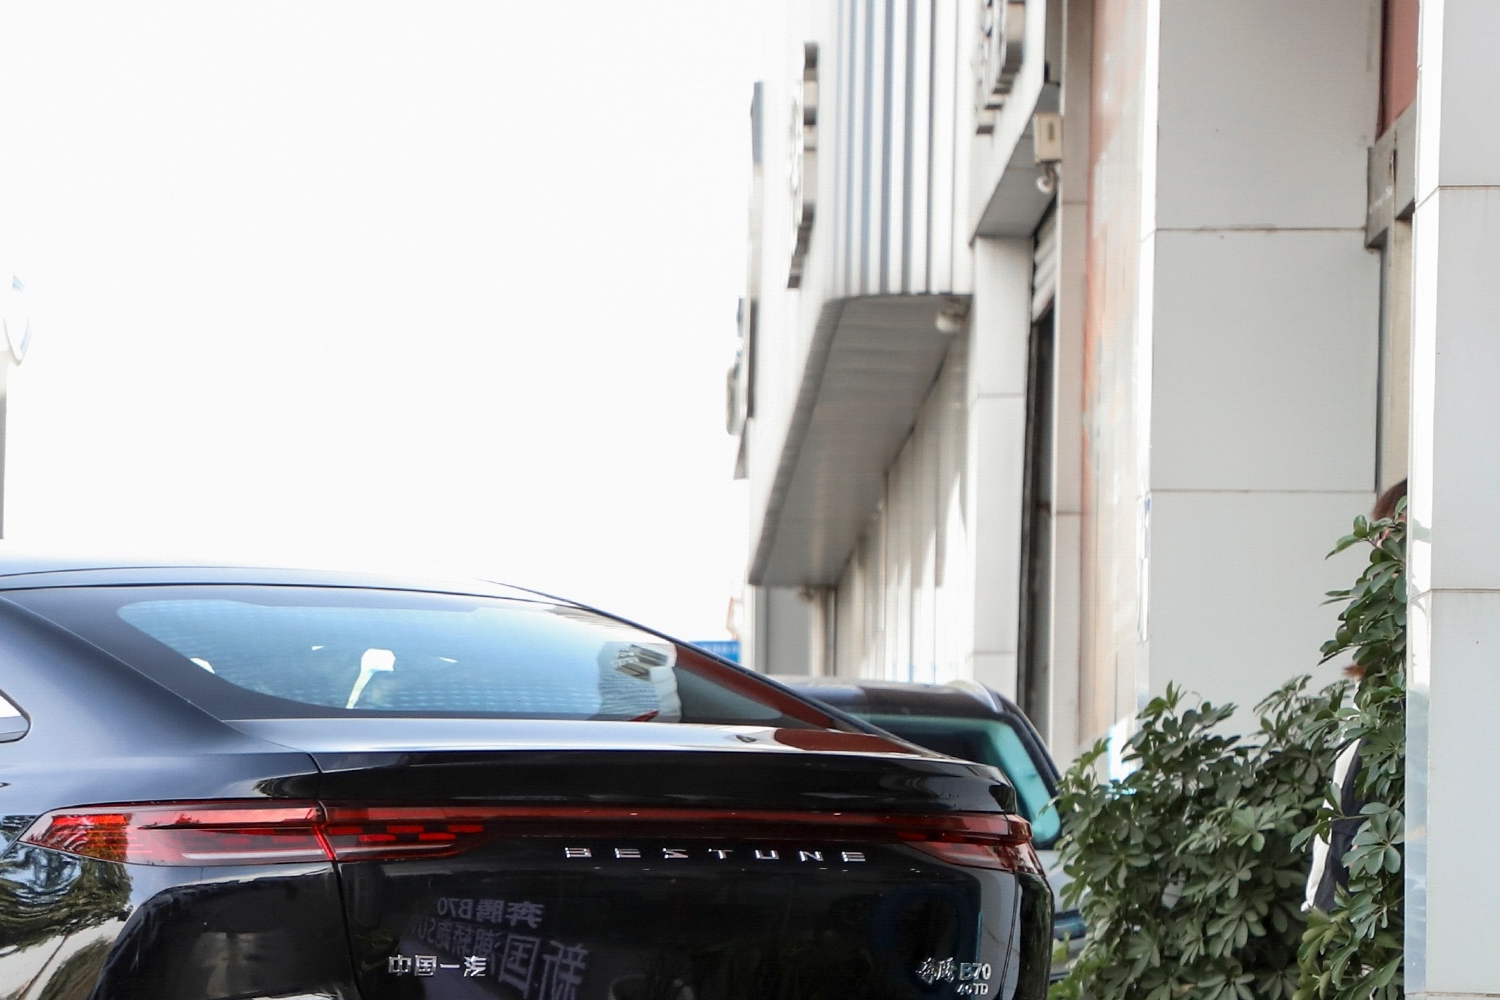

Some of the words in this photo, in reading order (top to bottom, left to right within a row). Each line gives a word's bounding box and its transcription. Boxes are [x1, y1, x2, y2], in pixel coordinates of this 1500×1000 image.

[564, 846, 866, 863] BESTUNE
[388, 954, 487, 978] 中国一汽
